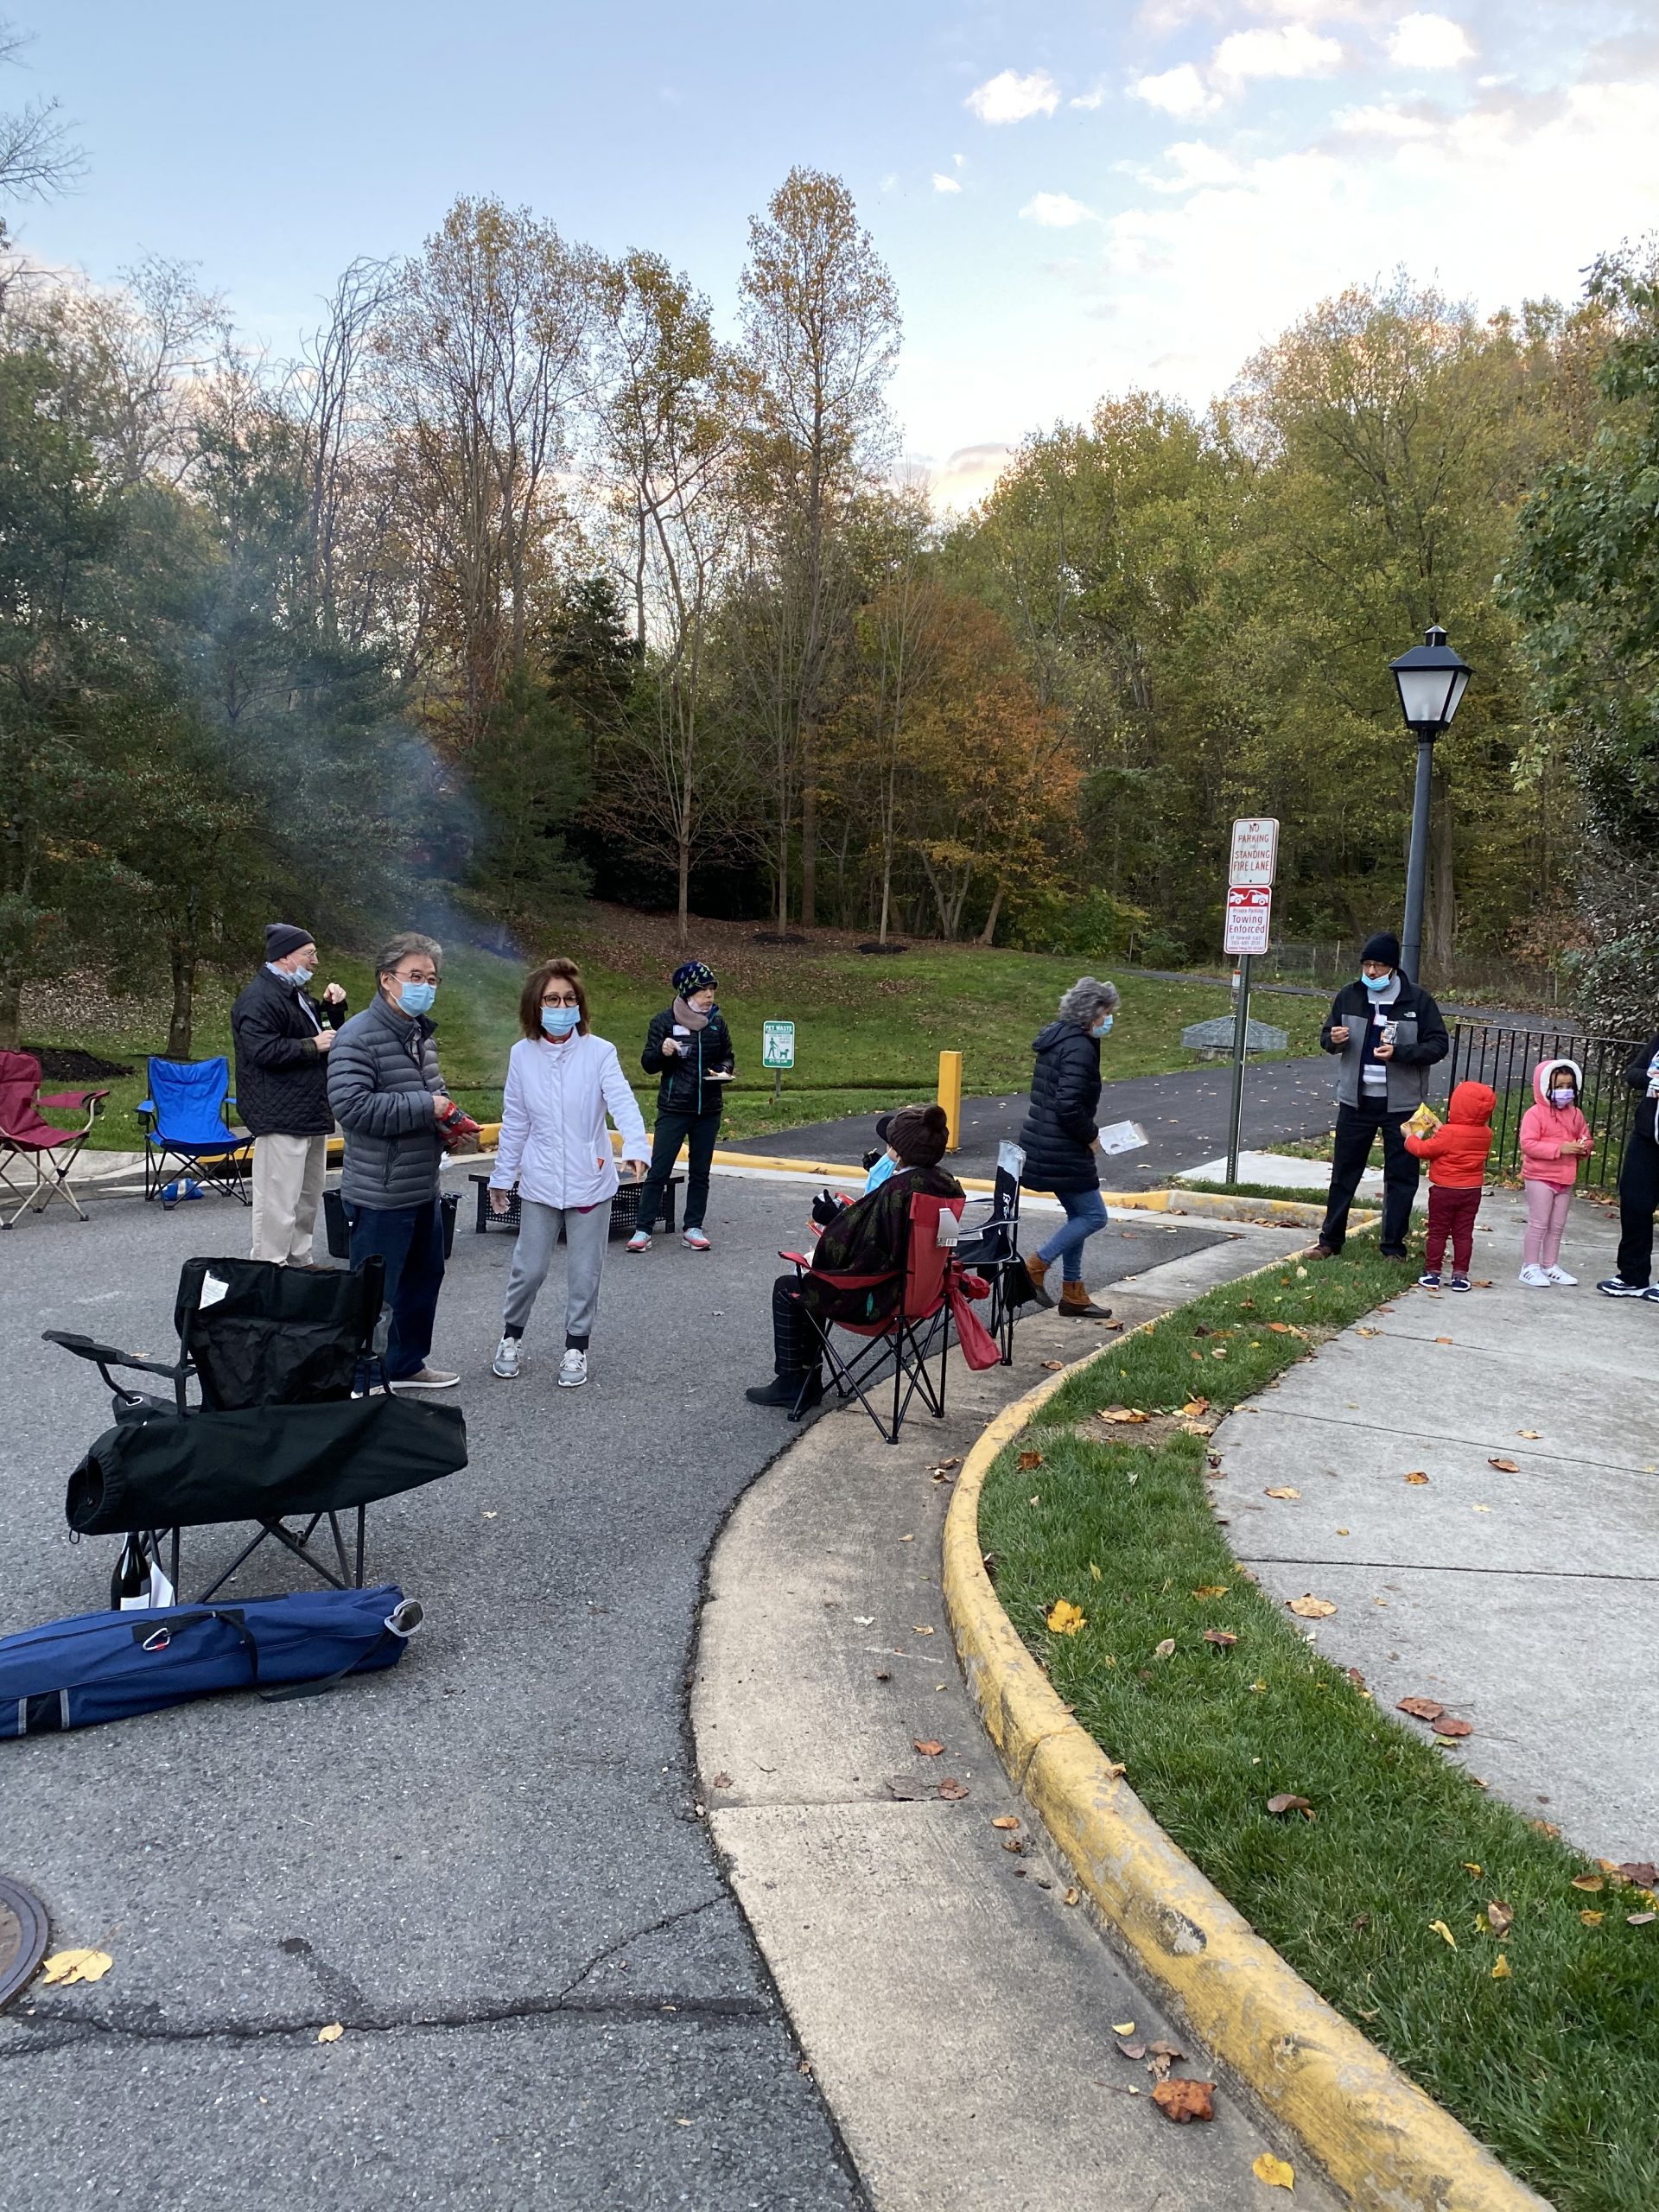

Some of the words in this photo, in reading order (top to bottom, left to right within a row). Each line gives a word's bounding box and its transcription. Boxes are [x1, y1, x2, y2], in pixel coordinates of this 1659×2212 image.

[1249, 823, 1259, 832] NO
[1235, 850, 1270, 859] STANDING
[1234, 861, 1249, 871] FIRE
[1250, 861, 1270, 871] LANE
[1233, 915, 1262, 925] Towing
